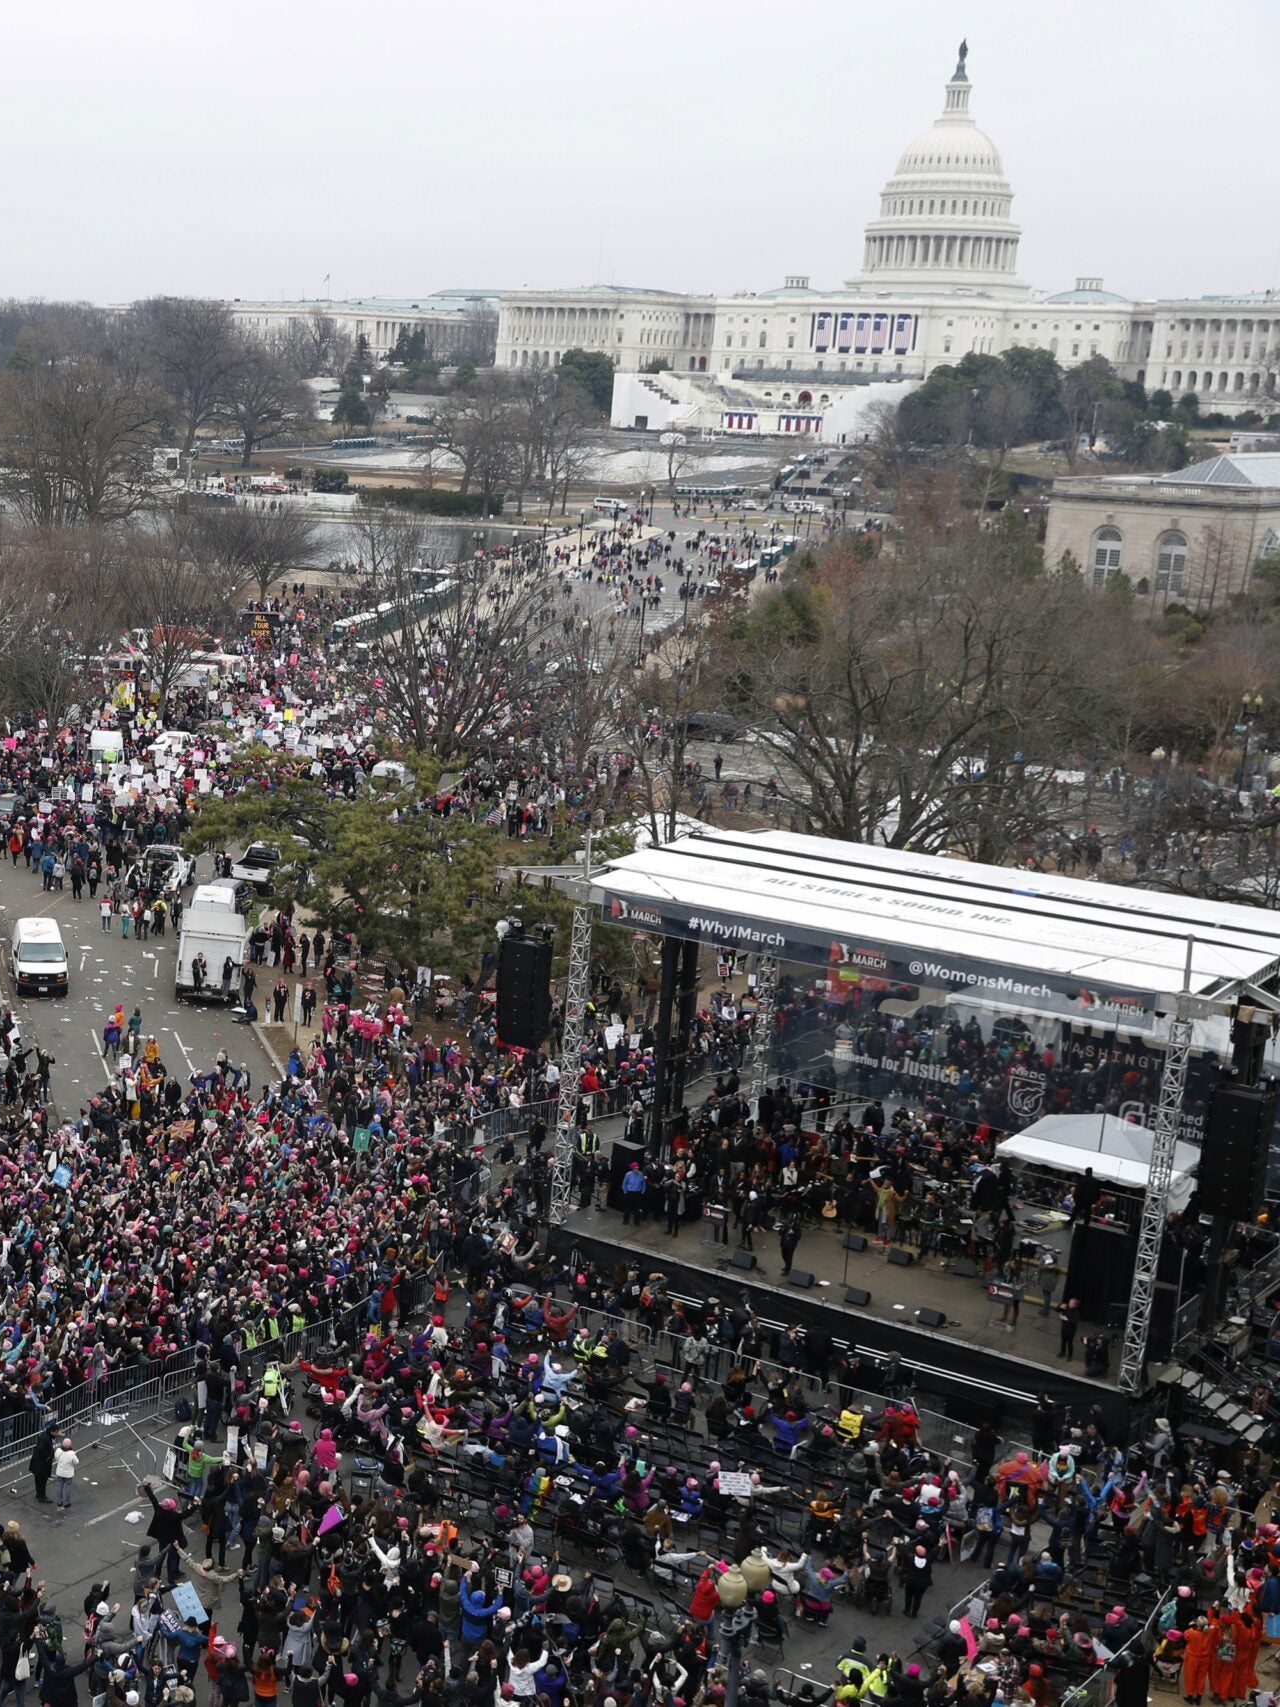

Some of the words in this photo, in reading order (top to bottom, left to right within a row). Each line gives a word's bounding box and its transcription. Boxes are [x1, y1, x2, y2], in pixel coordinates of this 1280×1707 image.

[763, 876, 797, 888] ALL
[800, 883, 864, 899] STAGE
[630, 909, 662, 925] MARCH
[688, 916, 786, 947] #WhyIMarch
[852, 953, 887, 970] MARCH
[908, 960, 1052, 999] @WomensMarch
[1104, 1000, 1144, 1017] MARCH
[1060, 1039, 1162, 1070] WASHINGT
[881, 1055, 900, 1072] for
[900, 1056, 961, 1086] Justice
[1011, 1066, 1047, 1081] NRDC
[164, 1610, 182, 1630] TRUST
